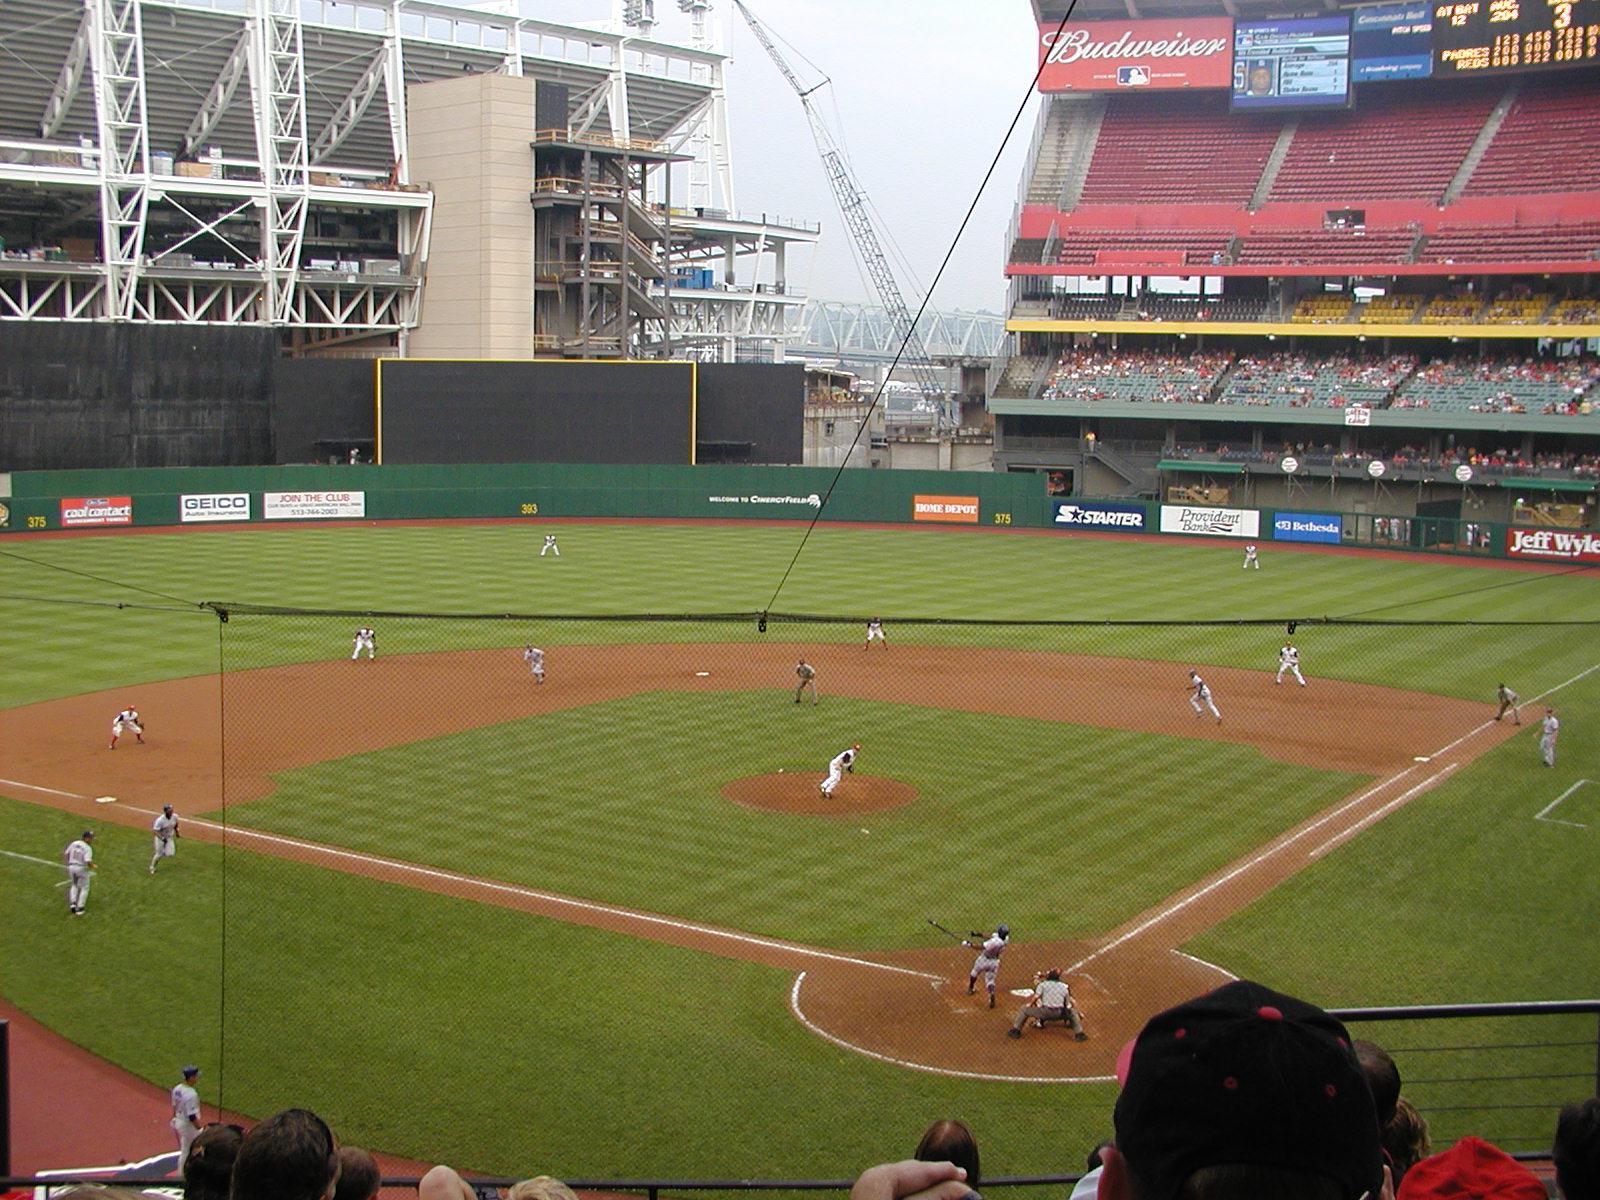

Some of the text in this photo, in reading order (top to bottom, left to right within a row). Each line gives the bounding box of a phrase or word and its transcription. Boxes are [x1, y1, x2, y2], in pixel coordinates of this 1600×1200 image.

[1451, 15, 1467, 26] 12
[1554, 3, 1572, 29] 3
[1042, 30, 1227, 64] Budweiser
[1442, 47, 1490, 61] PADRES
[1456, 57, 1489, 70] REDS
[184, 497, 247, 509] GEICO
[280, 493, 350, 502] JOIN THE CLUB
[521, 503, 538, 514] 393
[915, 503, 977, 515] HOME DEPOT
[27, 516, 47, 528] 375
[994, 512, 1011, 525] 375
[1083, 510, 1143, 527] STARTER
[1179, 508, 1240, 524] Provident
[1183, 519, 1210, 532] Bank
[1293, 521, 1339, 533] Bethesda
[1510, 530, 1553, 552] Jeff
